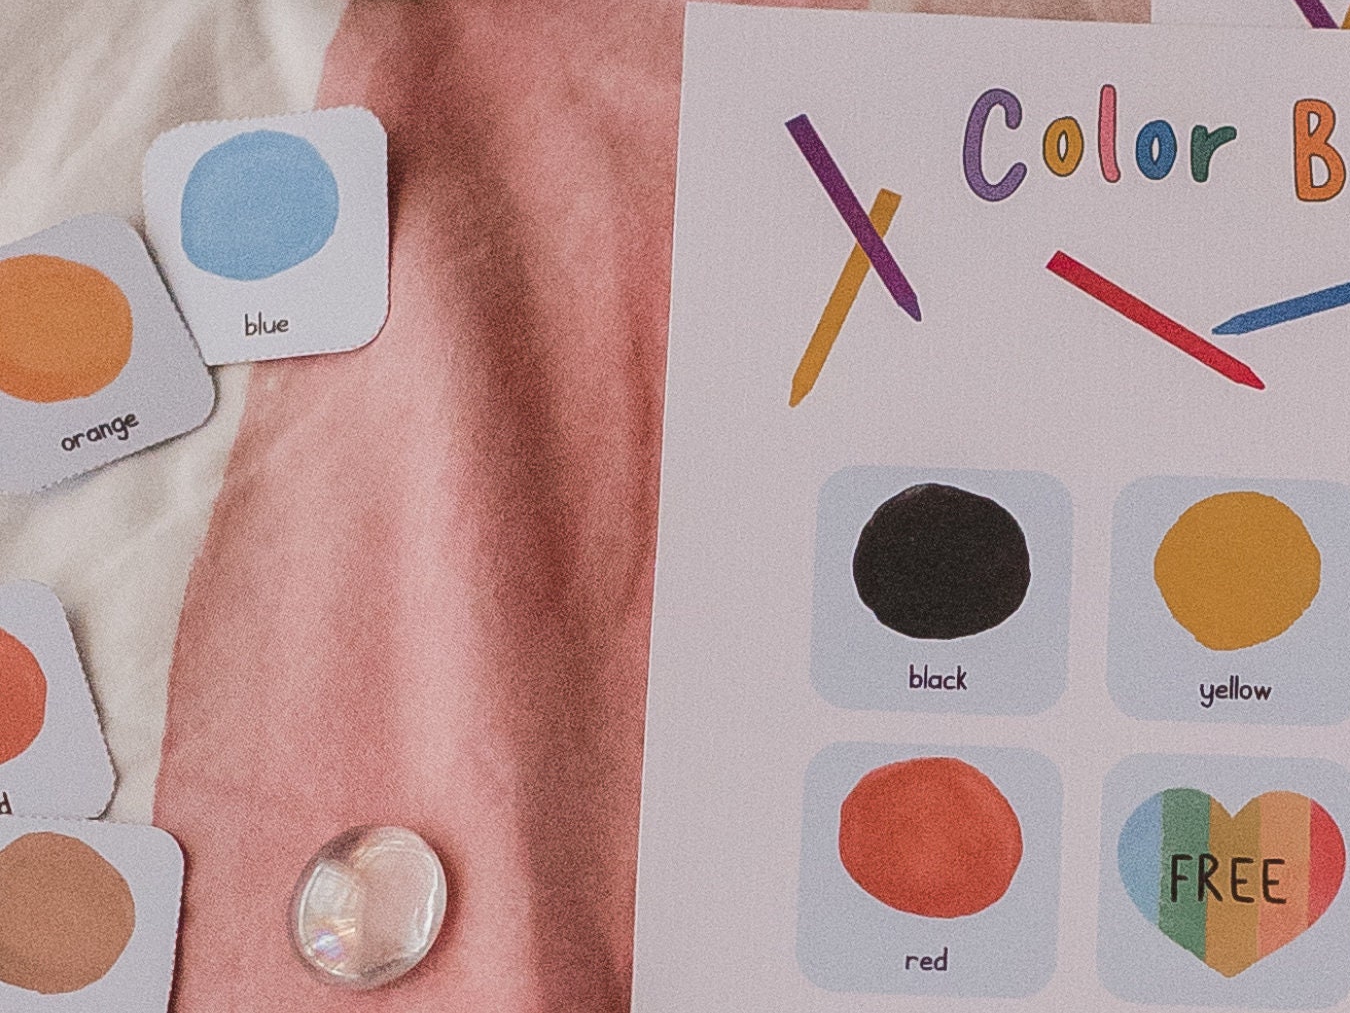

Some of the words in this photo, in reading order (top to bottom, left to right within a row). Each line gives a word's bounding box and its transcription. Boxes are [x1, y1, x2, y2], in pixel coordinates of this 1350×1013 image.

[962, 84, 1237, 202] Color
[244, 312, 289, 336] blue
[61, 413, 140, 452] orange
[909, 665, 967, 690] black
[1200, 676, 1271, 708] yellow
[1171, 854, 1285, 903] FREE
[905, 947, 948, 971] red
